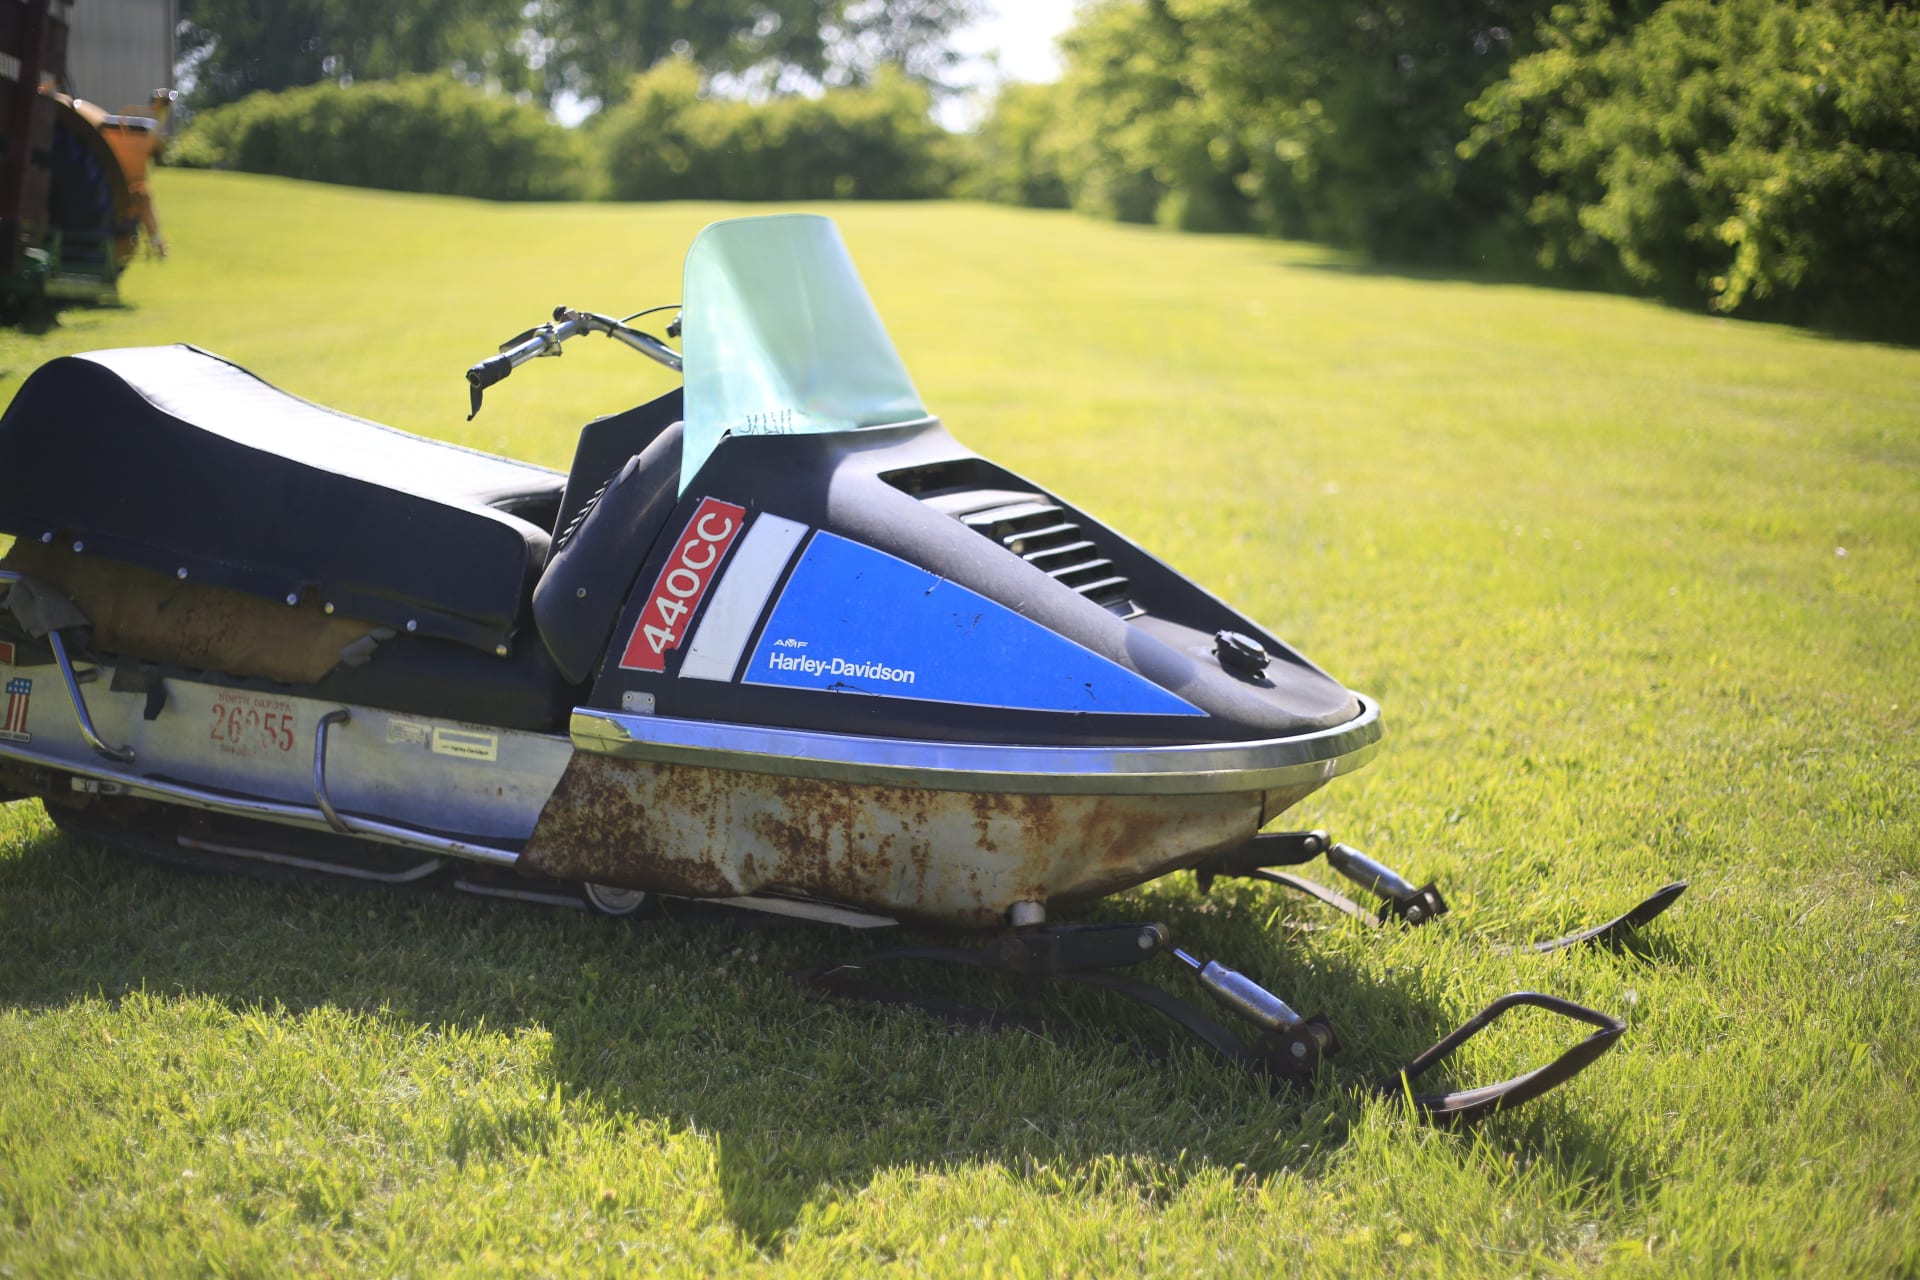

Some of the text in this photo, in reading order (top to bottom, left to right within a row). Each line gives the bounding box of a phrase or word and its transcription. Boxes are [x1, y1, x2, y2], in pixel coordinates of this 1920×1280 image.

[643, 512, 732, 654] 440CC
[774, 639, 808, 648] AMF
[769, 652, 915, 684] Harley-Davidson
